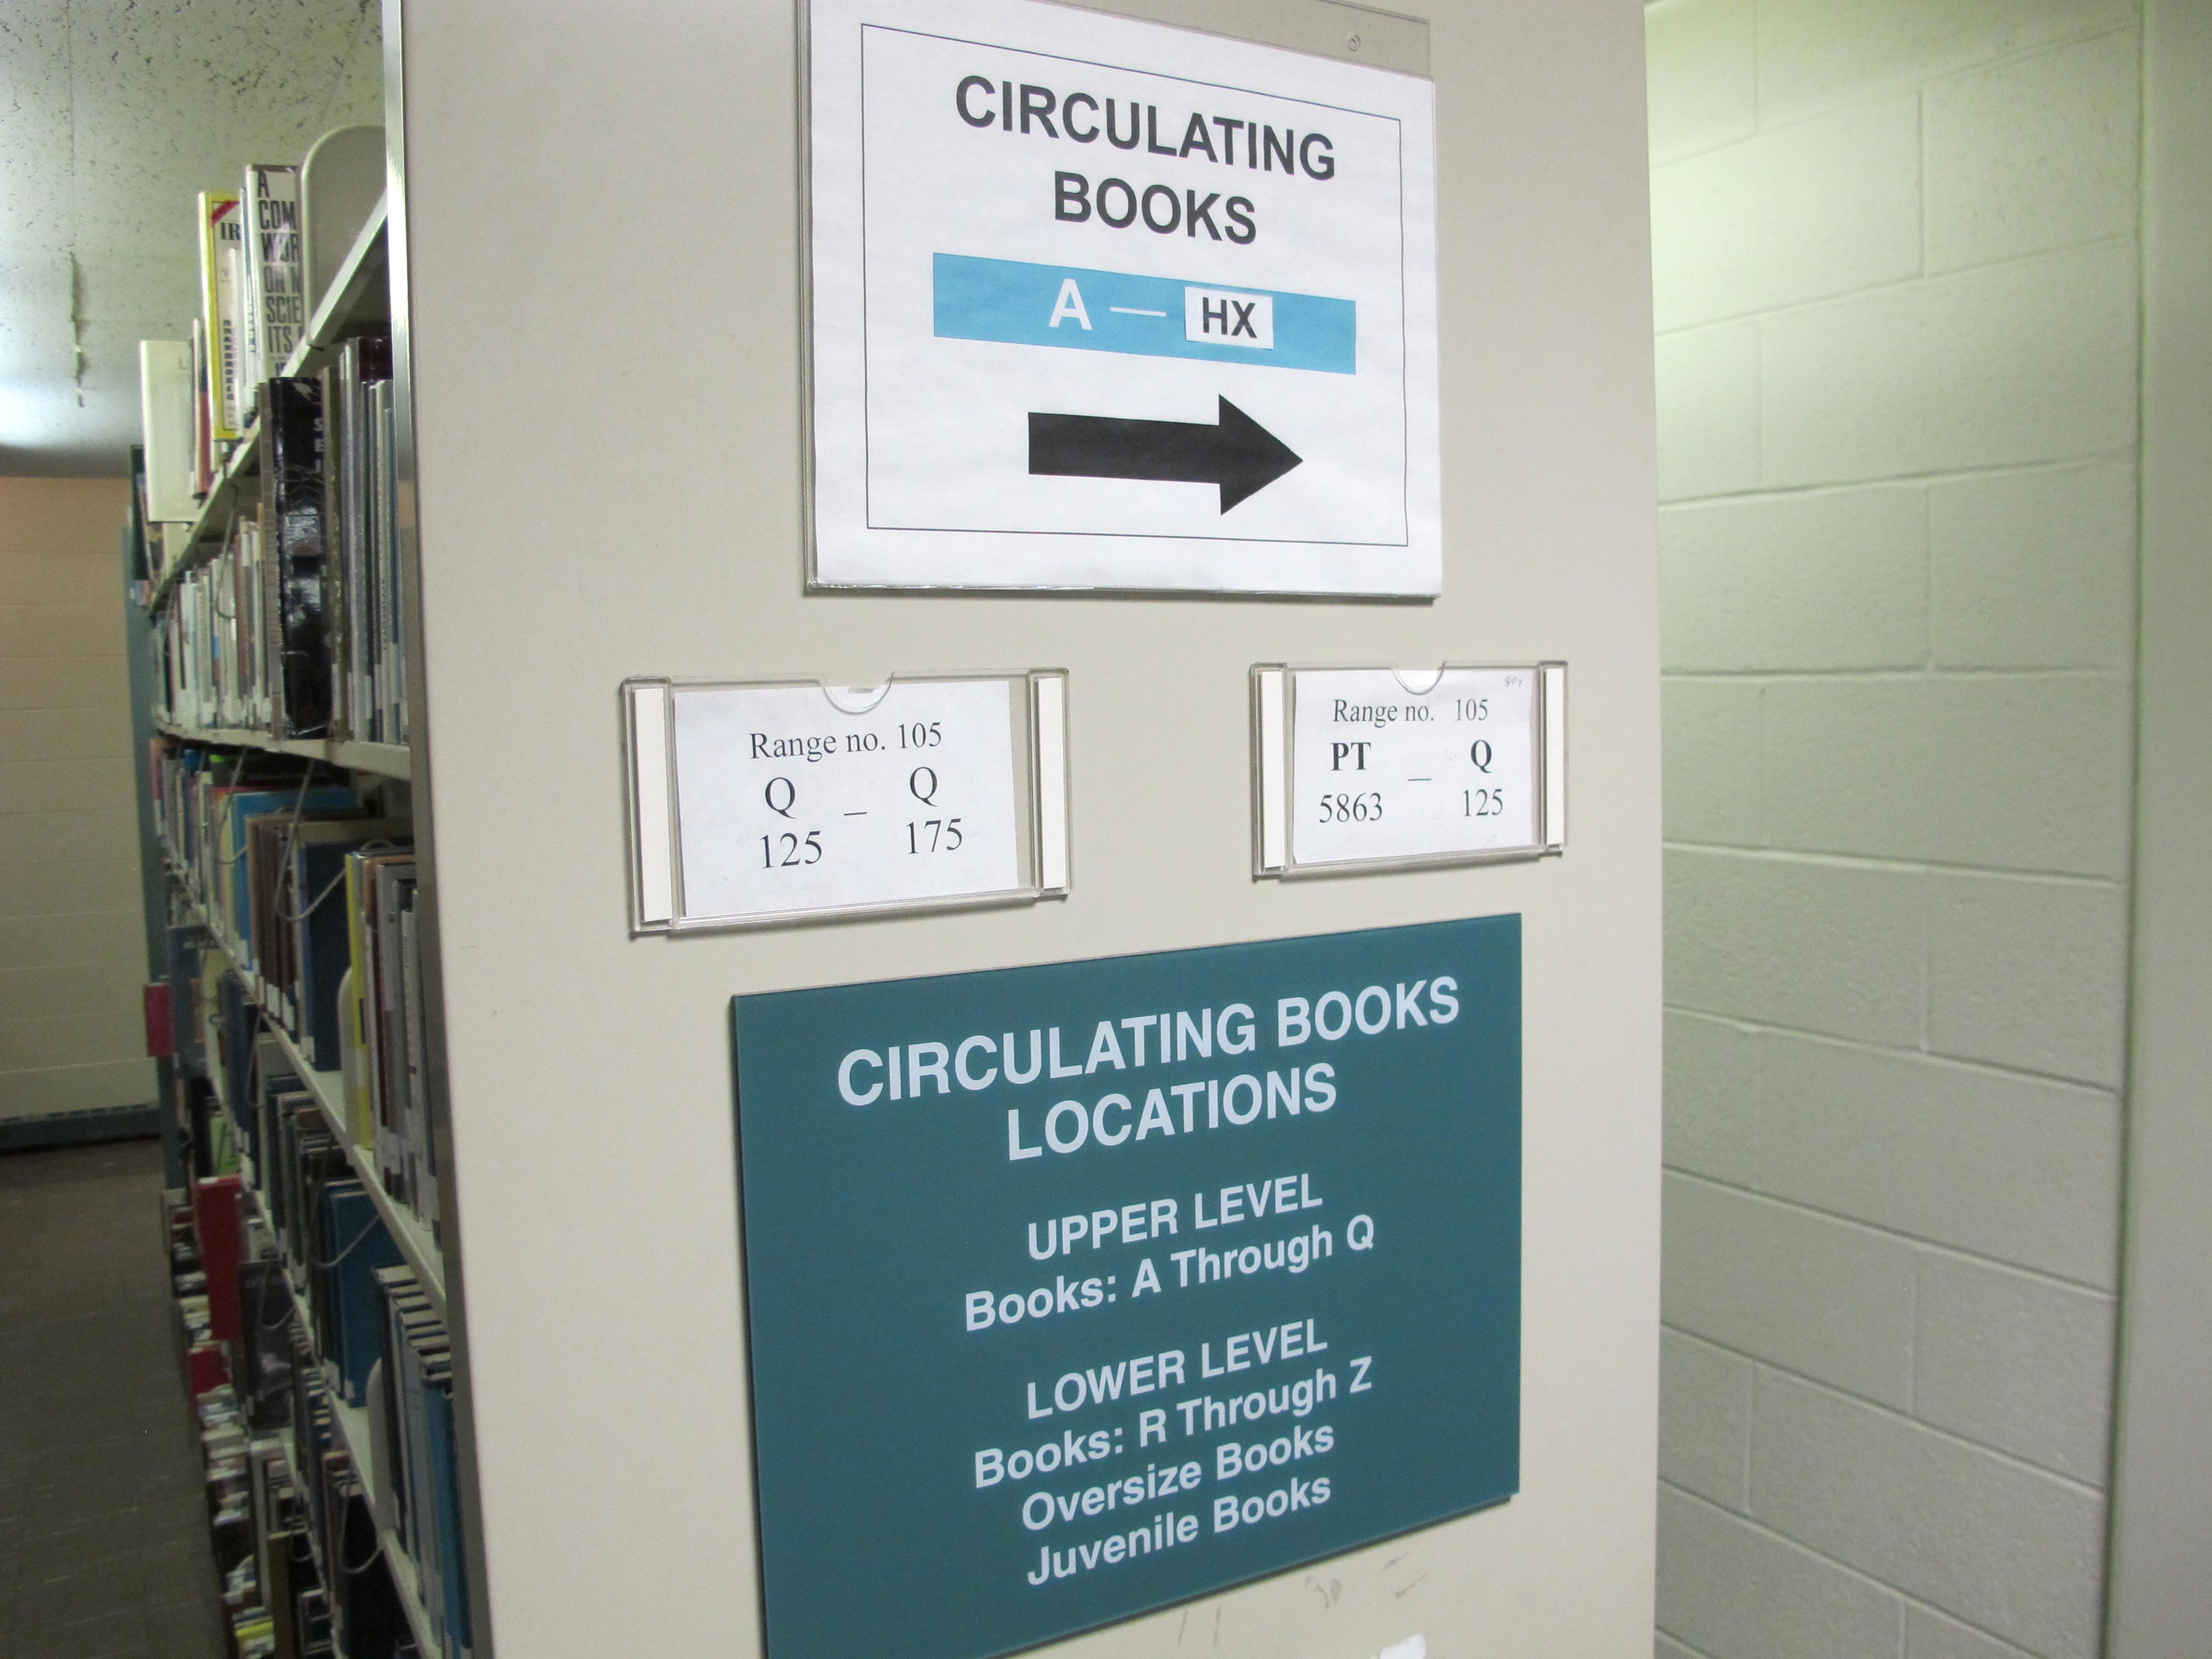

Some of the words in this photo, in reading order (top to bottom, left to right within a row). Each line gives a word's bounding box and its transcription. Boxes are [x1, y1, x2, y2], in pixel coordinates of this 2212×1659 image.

[956, 74, 1336, 182] CIRCULATING
[1054, 170, 1257, 245] BOOKS
[1048, 278, 1093, 331] A
[1202, 297, 1257, 339] HX
[749, 733, 837, 763] Range
[845, 733, 887, 753] no.
[899, 722, 941, 749] 105
[1332, 742, 1371, 771] PT
[1470, 739, 1492, 774] Q
[1333, 699, 1398, 729] Range
[1405, 705, 1435, 721] no.
[1456, 699, 1488, 721] 105
[764, 777, 796, 819] Q
[909, 766, 938, 807] Q
[1319, 792, 1382, 823] 5863
[1464, 788, 1503, 817] 125
[761, 830, 822, 868] 125
[906, 818, 962, 854] 175
[837, 1003, 1255, 1106] CIRCULATING
[1277, 976, 1459, 1047] BOOKS
[1008, 1062, 1336, 1161] LOCATIONS
[1028, 1198, 1179, 1260] UPPER
[1194, 1173, 1323, 1230] LEVEL
[965, 1275, 1116, 1332] Books:
[1131, 1258, 1162, 1298] A
[1170, 1224, 1333, 1288] Through
[1346, 1214, 1374, 1251] Q
[1027, 1349, 1185, 1419] LOWER
[1201, 1318, 1328, 1378] LEVEL
[975, 1427, 1123, 1489] Books:
[1139, 1408, 1167, 1448] R
[1176, 1368, 1336, 1436] Through
[1349, 1355, 1372, 1394] Z
[1022, 1461, 1202, 1531] Oversize
[1217, 1426, 1334, 1480] Books
[1027, 1512, 1199, 1585] Juvenile
[1214, 1477, 1331, 1533] Books
